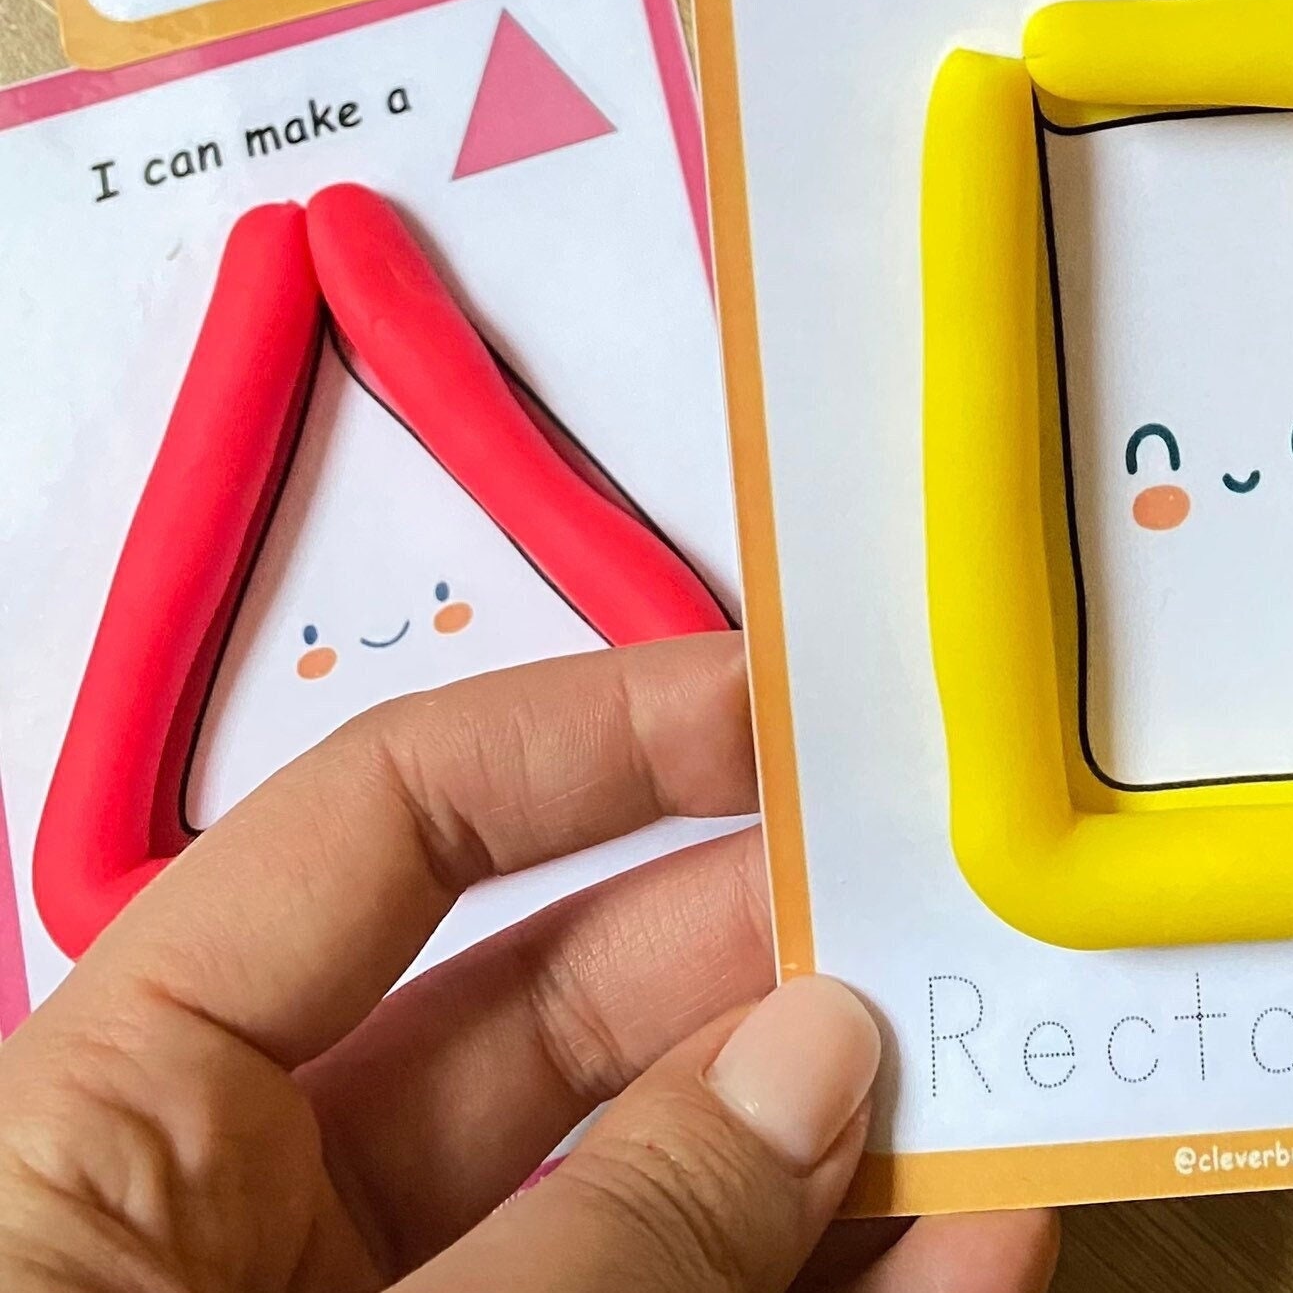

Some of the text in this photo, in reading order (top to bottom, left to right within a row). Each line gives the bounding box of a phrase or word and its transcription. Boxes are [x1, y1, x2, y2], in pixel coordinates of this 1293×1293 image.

[91, 86, 413, 203] I can make a
